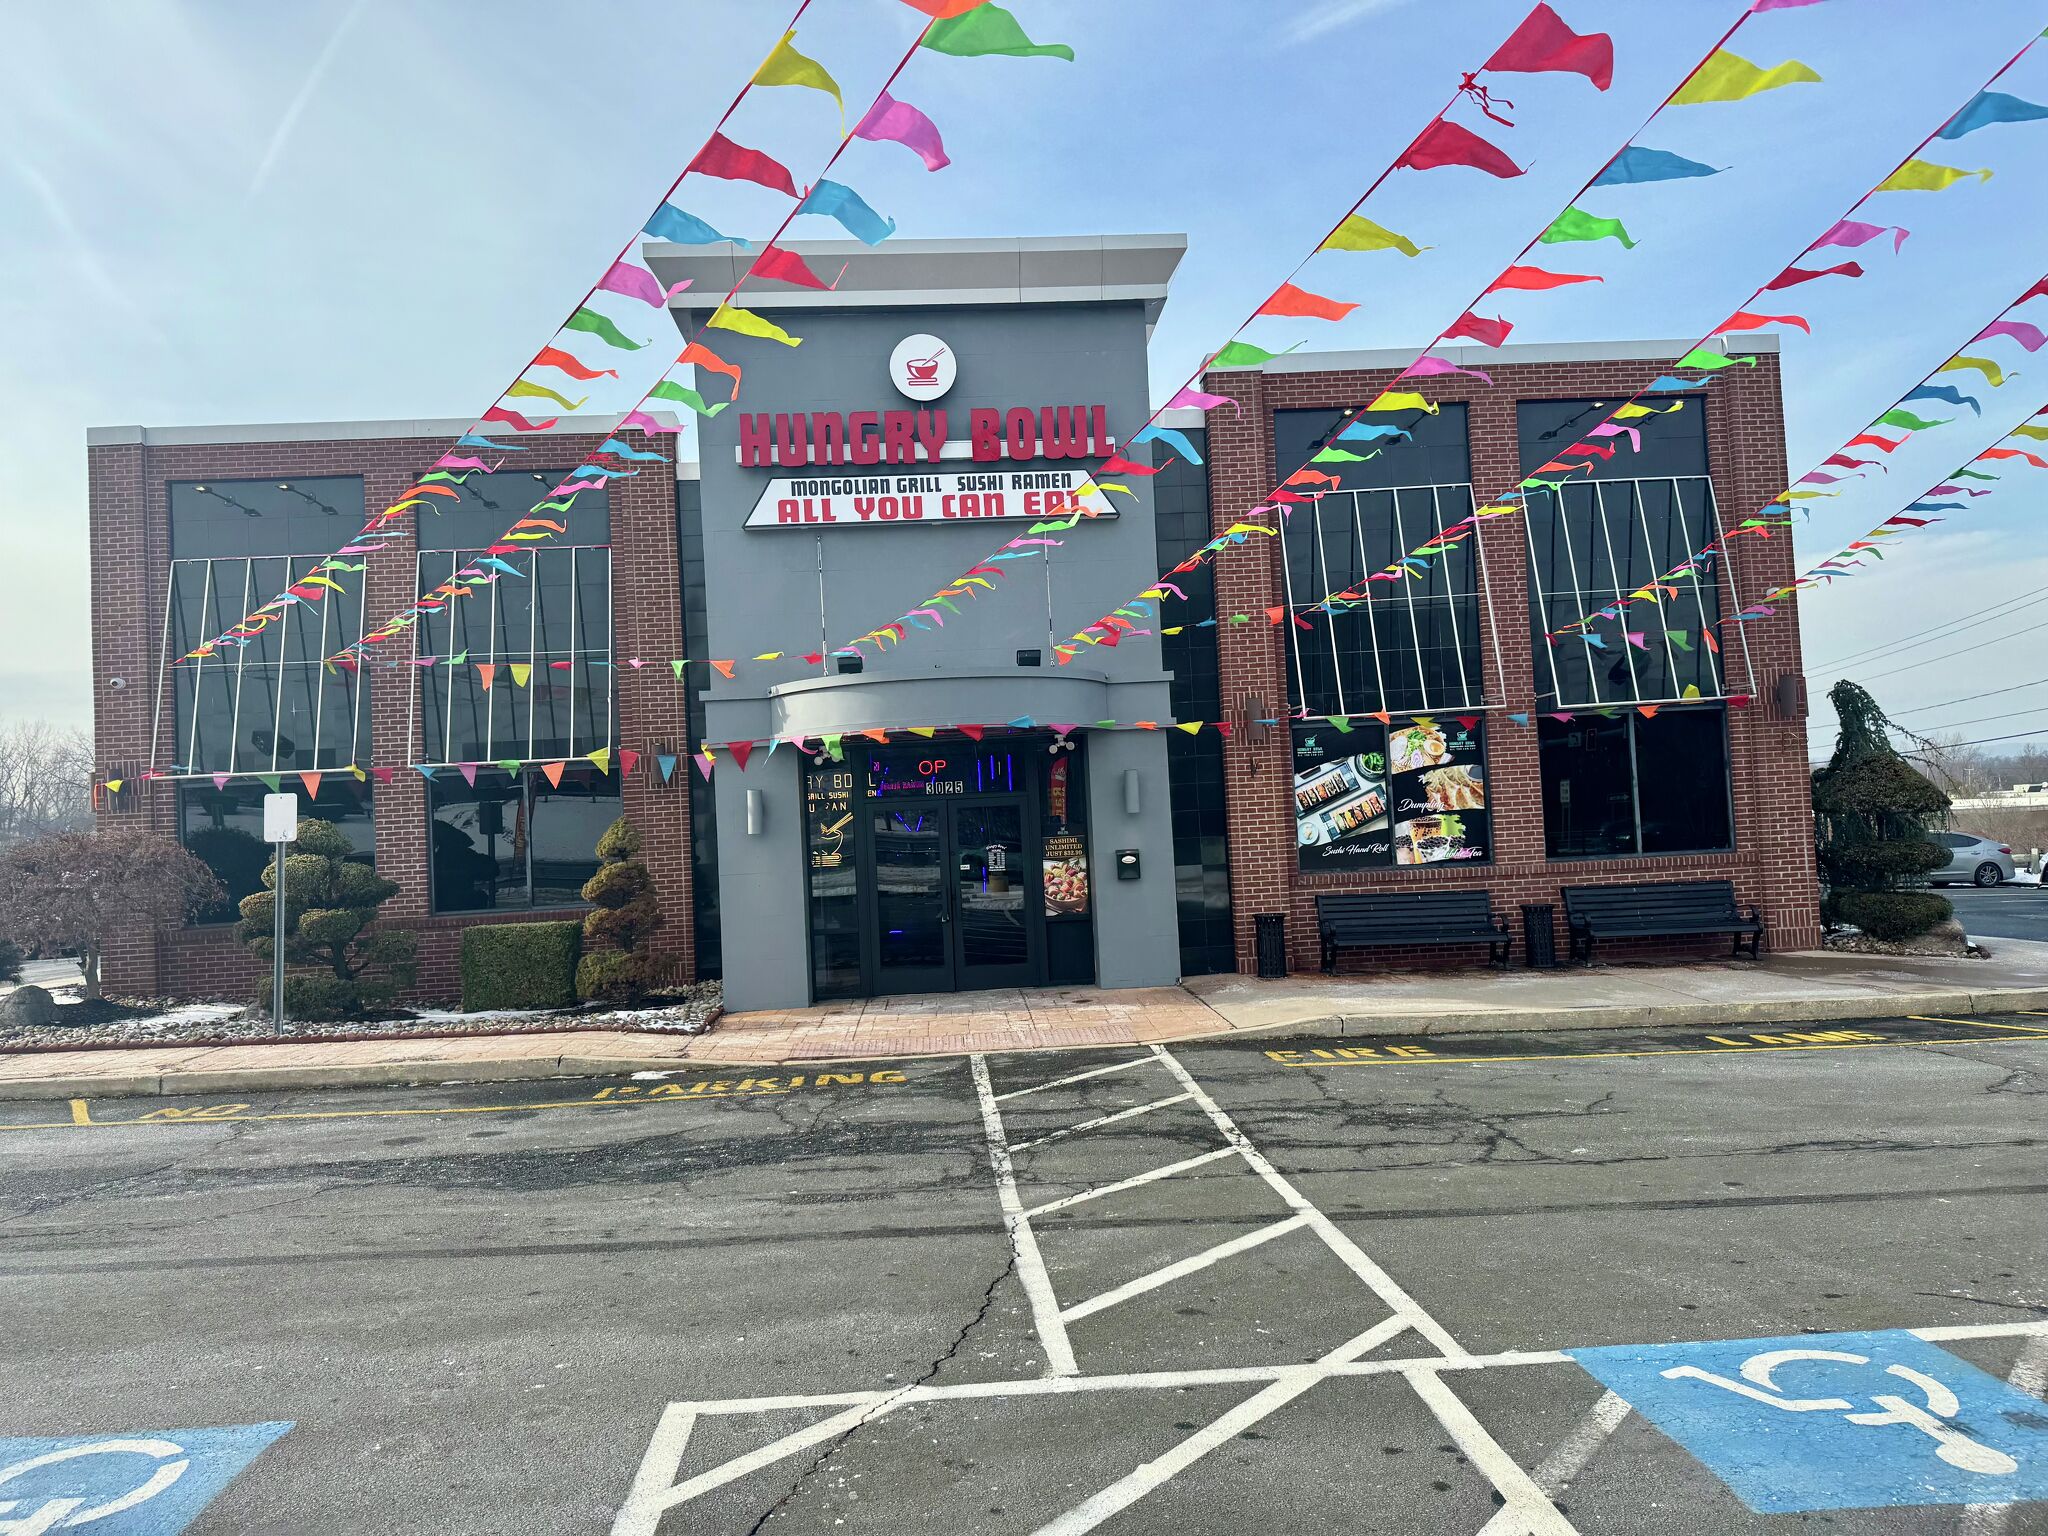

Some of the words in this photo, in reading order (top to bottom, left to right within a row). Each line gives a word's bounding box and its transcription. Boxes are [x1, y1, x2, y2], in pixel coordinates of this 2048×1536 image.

[739, 408, 949, 468] HUNGRY
[970, 405, 1115, 462] BOWL
[790, 478, 891, 497] MONGOLIAN
[896, 476, 942, 494] GRILL
[957, 474, 1004, 492] SUSHI
[1011, 472, 1072, 490] RAMEN
[777, 498, 837, 523] ALL
[853, 495, 923, 521] YOU
[941, 492, 1005, 518] CAN
[925, 780, 964, 795] 3025
[1397, 798, 1446, 813] Dumpling
[1045, 843, 1083, 851] UNLIMITED
[1049, 837, 1078, 845] SASHIMI
[1322, 845, 1346, 857] Sushi
[1345, 844, 1371, 855] Hand
[1370, 842, 1390, 854] Roll
[1263, 1044, 1438, 1063] FIRE
[1704, 1030, 1888, 1047] LANE
[138, 1103, 251, 1120] NO
[592, 1069, 907, 1100] PARKING
